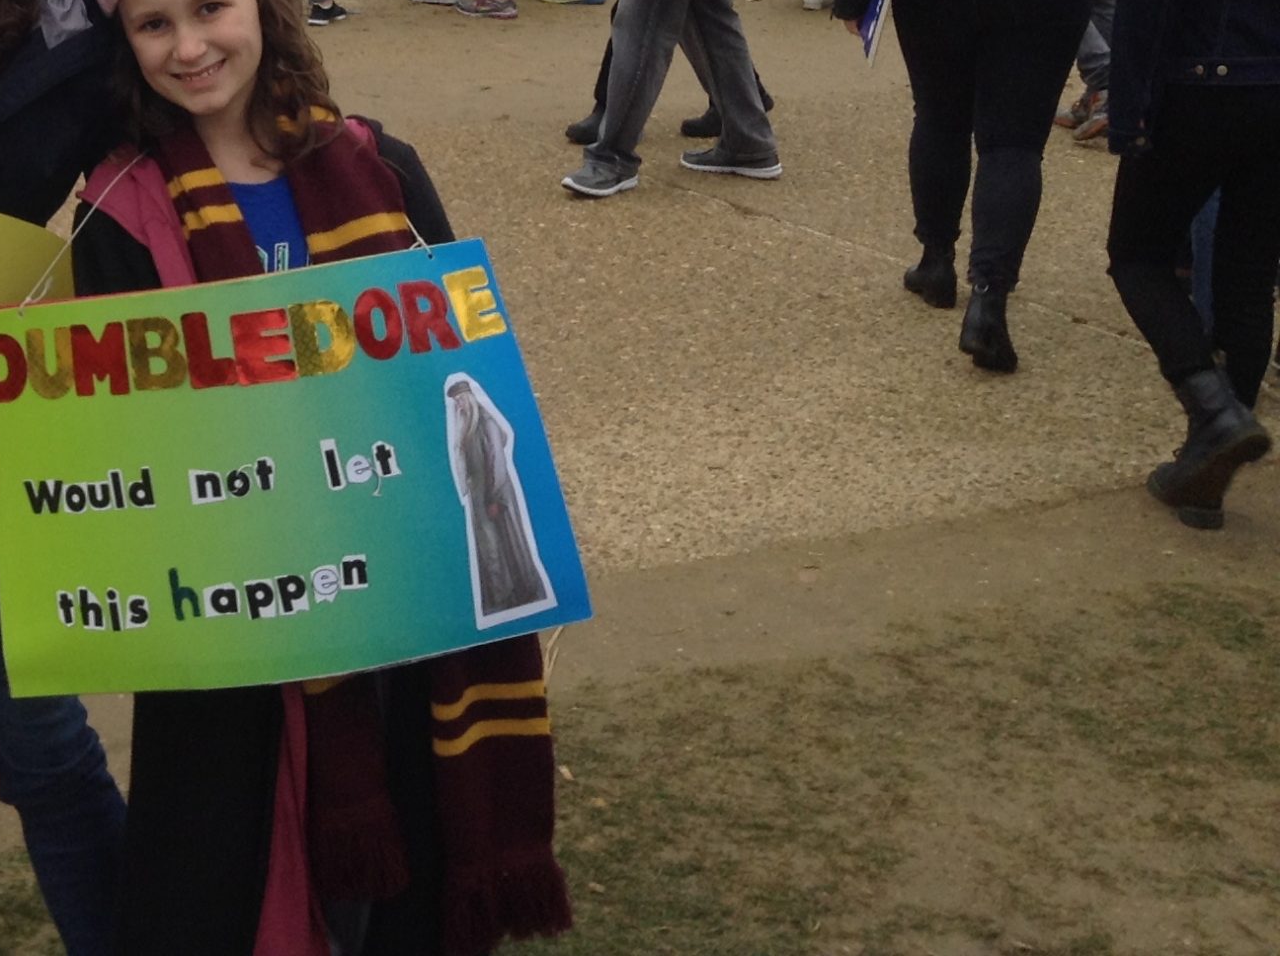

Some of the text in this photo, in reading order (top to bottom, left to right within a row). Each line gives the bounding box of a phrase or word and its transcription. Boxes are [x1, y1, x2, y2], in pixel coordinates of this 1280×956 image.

[24, 440, 397, 514] Would not let
[58, 554, 369, 632] this happen
